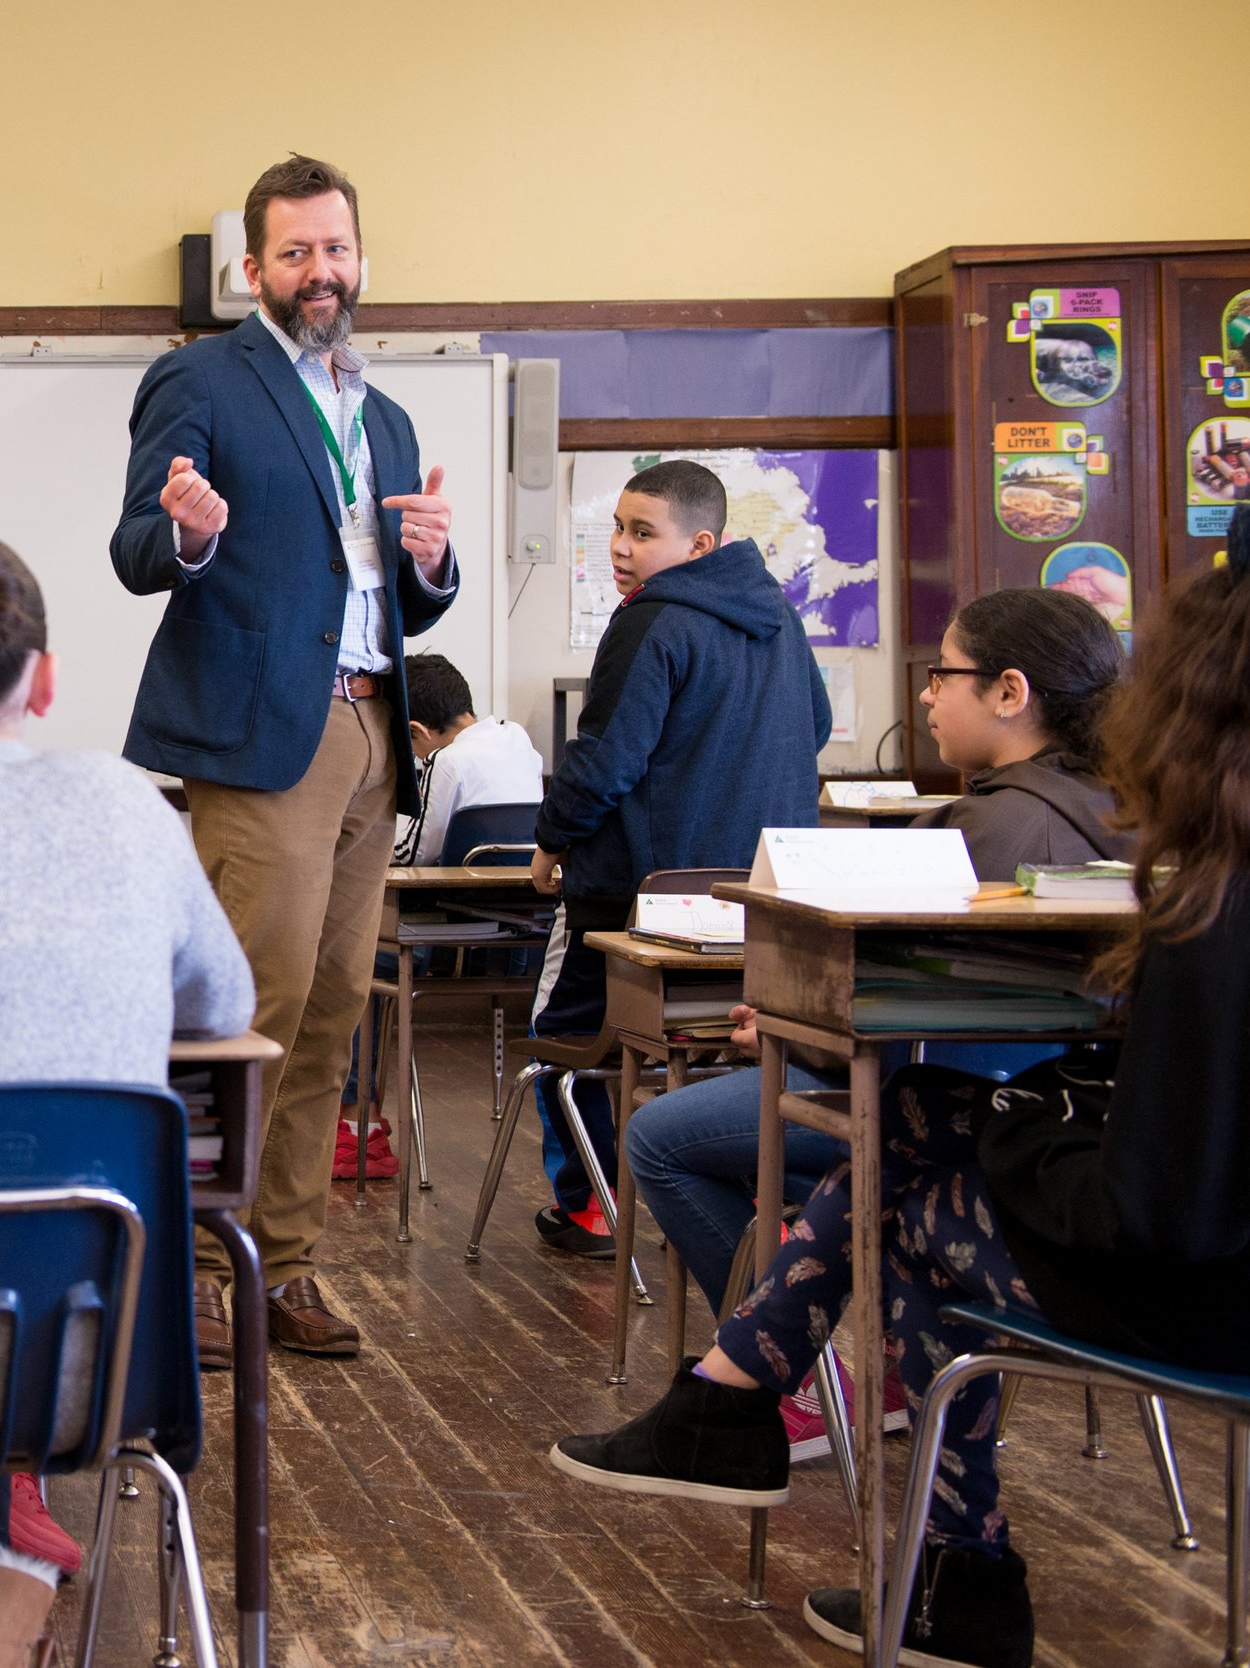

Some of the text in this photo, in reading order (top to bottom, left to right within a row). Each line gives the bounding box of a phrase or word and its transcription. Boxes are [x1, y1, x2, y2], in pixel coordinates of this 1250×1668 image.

[1075, 291, 1098, 299] SNIP
[1010, 426, 1048, 436] DON'T
[1007, 437, 1051, 448] LITTER
